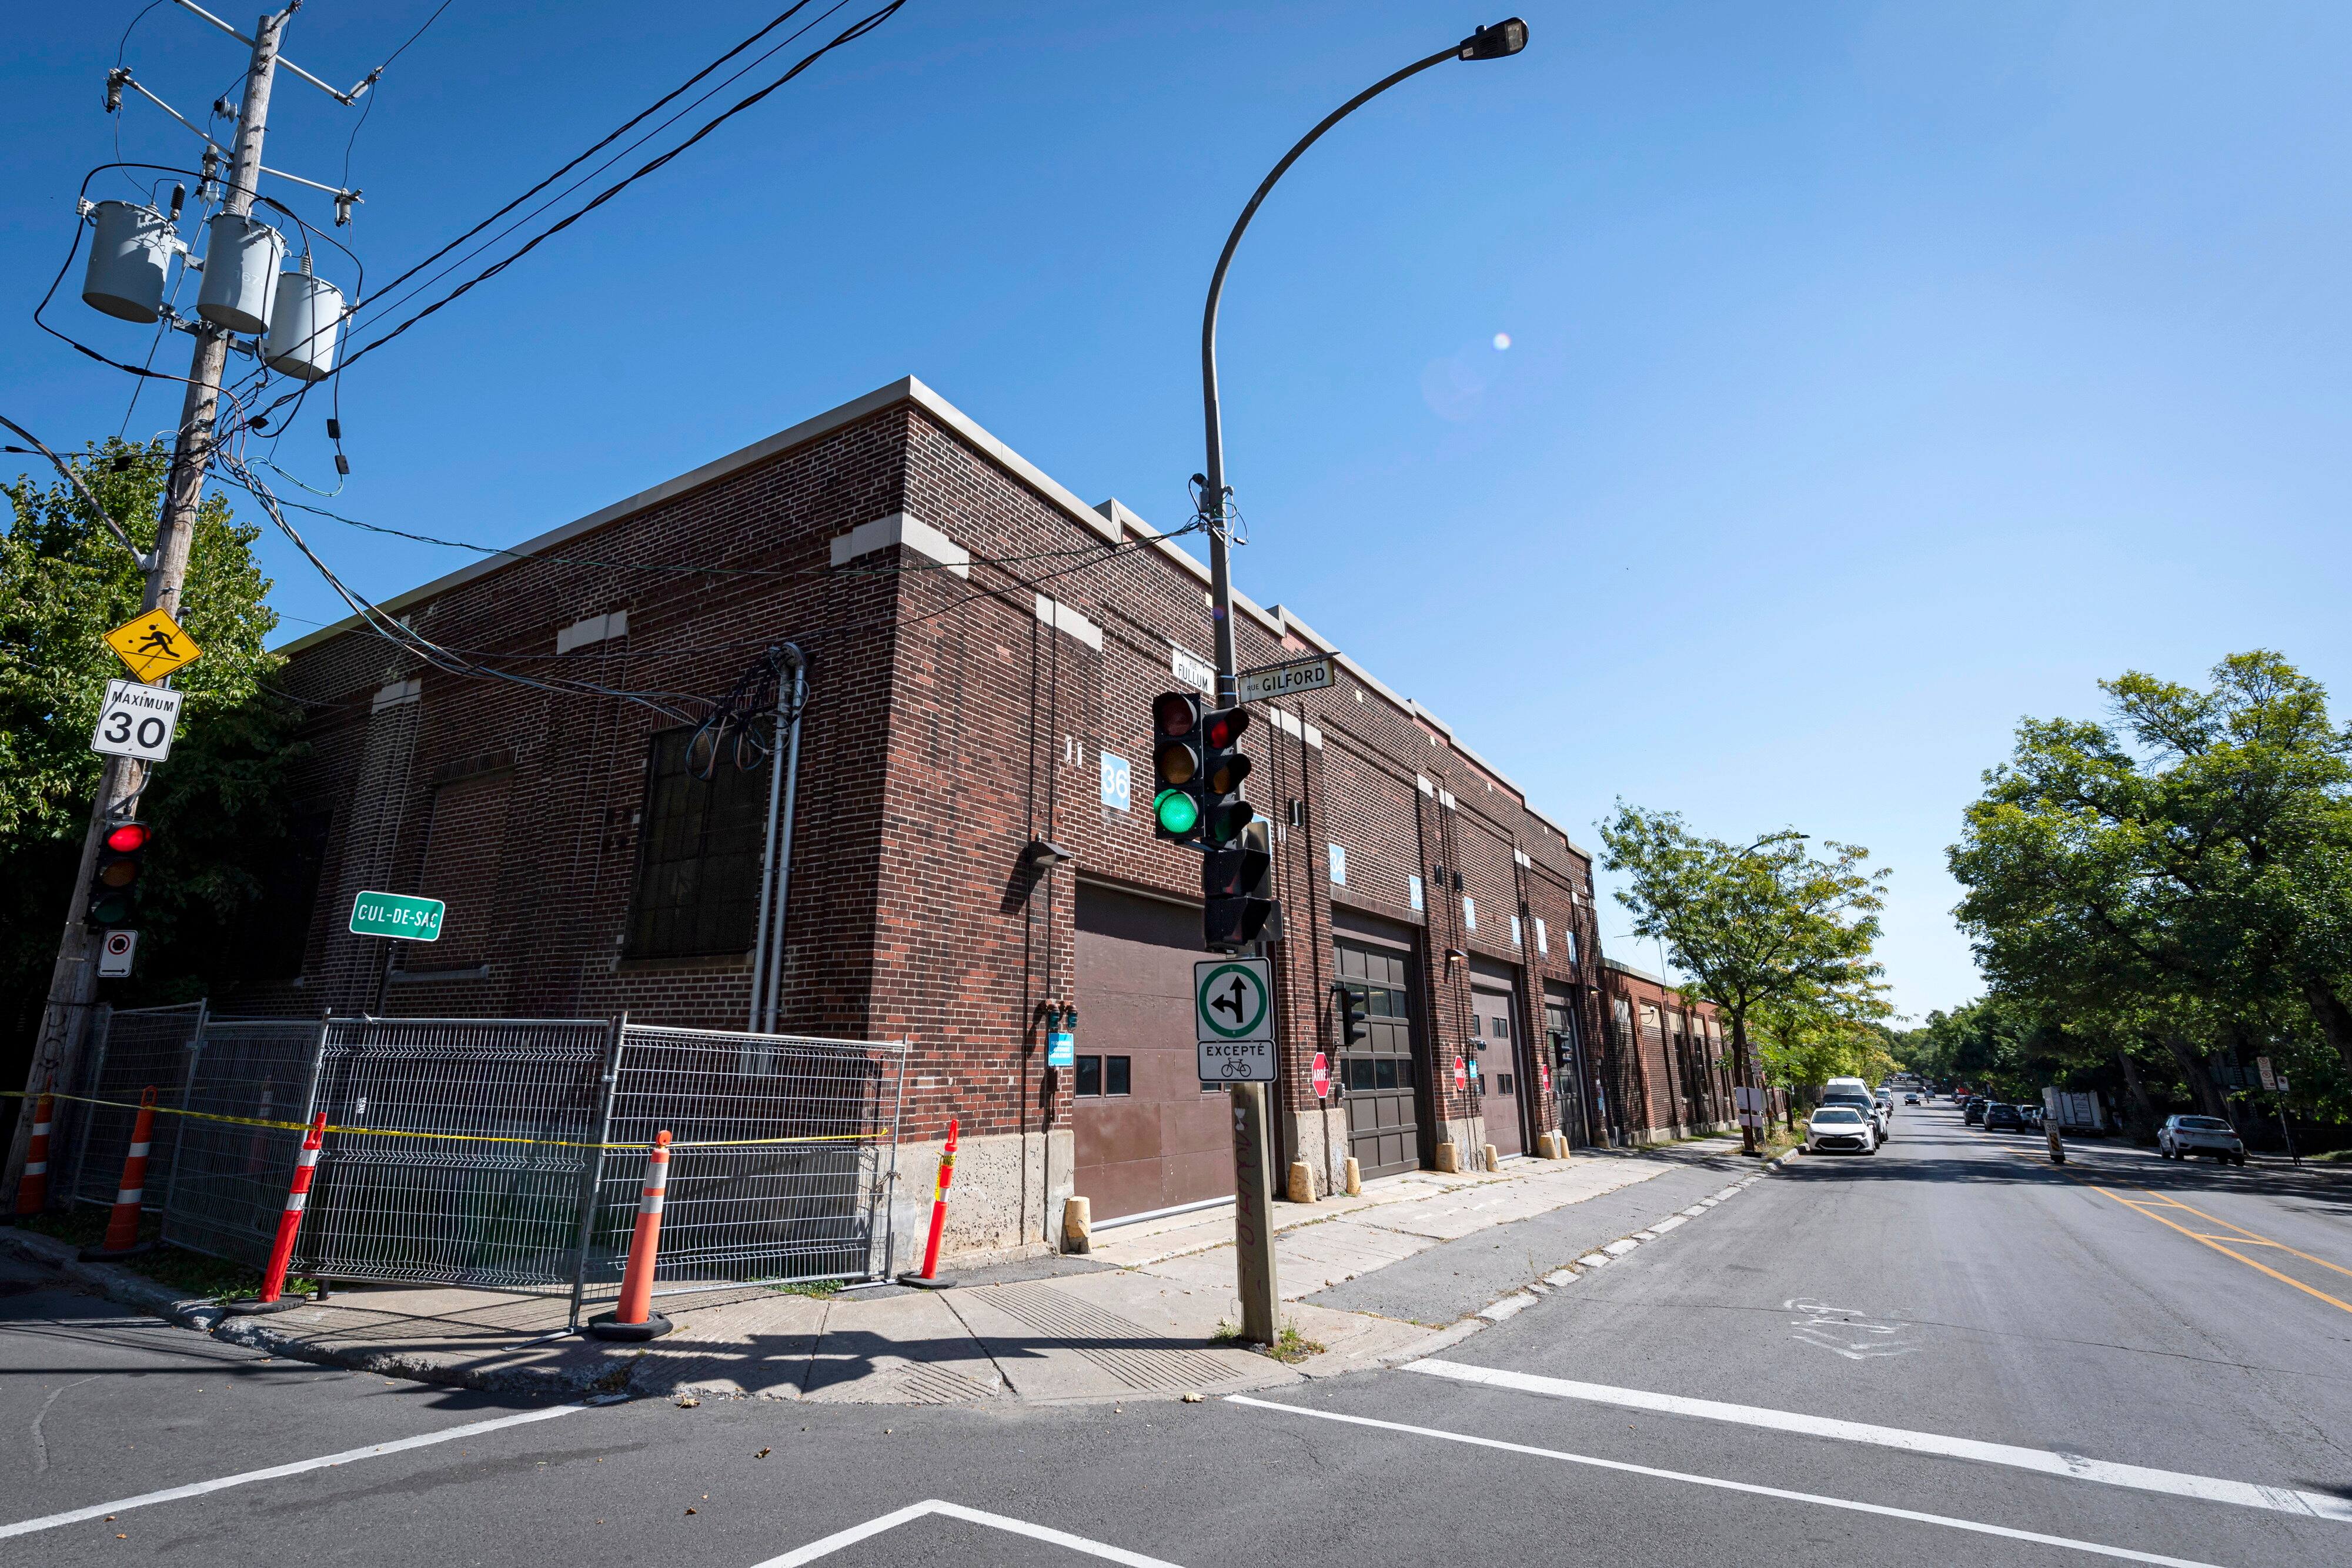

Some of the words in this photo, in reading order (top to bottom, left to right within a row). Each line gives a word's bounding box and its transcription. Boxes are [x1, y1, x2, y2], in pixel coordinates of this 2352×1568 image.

[1178, 663, 1208, 691] FULLUM
[1247, 683, 1259, 692] RUE
[1262, 667, 1325, 691] GILFORD
[112, 691, 174, 712] MAXIMUM
[105, 711, 166, 748] 30
[1102, 764, 1128, 799] 36
[1330, 852, 1344, 875] 34
[1411, 883, 1422, 902] 33
[358, 904, 438, 928] CUL-DE-SAC
[1207, 1043, 1265, 1056] EXCEPTÉ
[1314, 1066, 1329, 1081] ARRÊT
